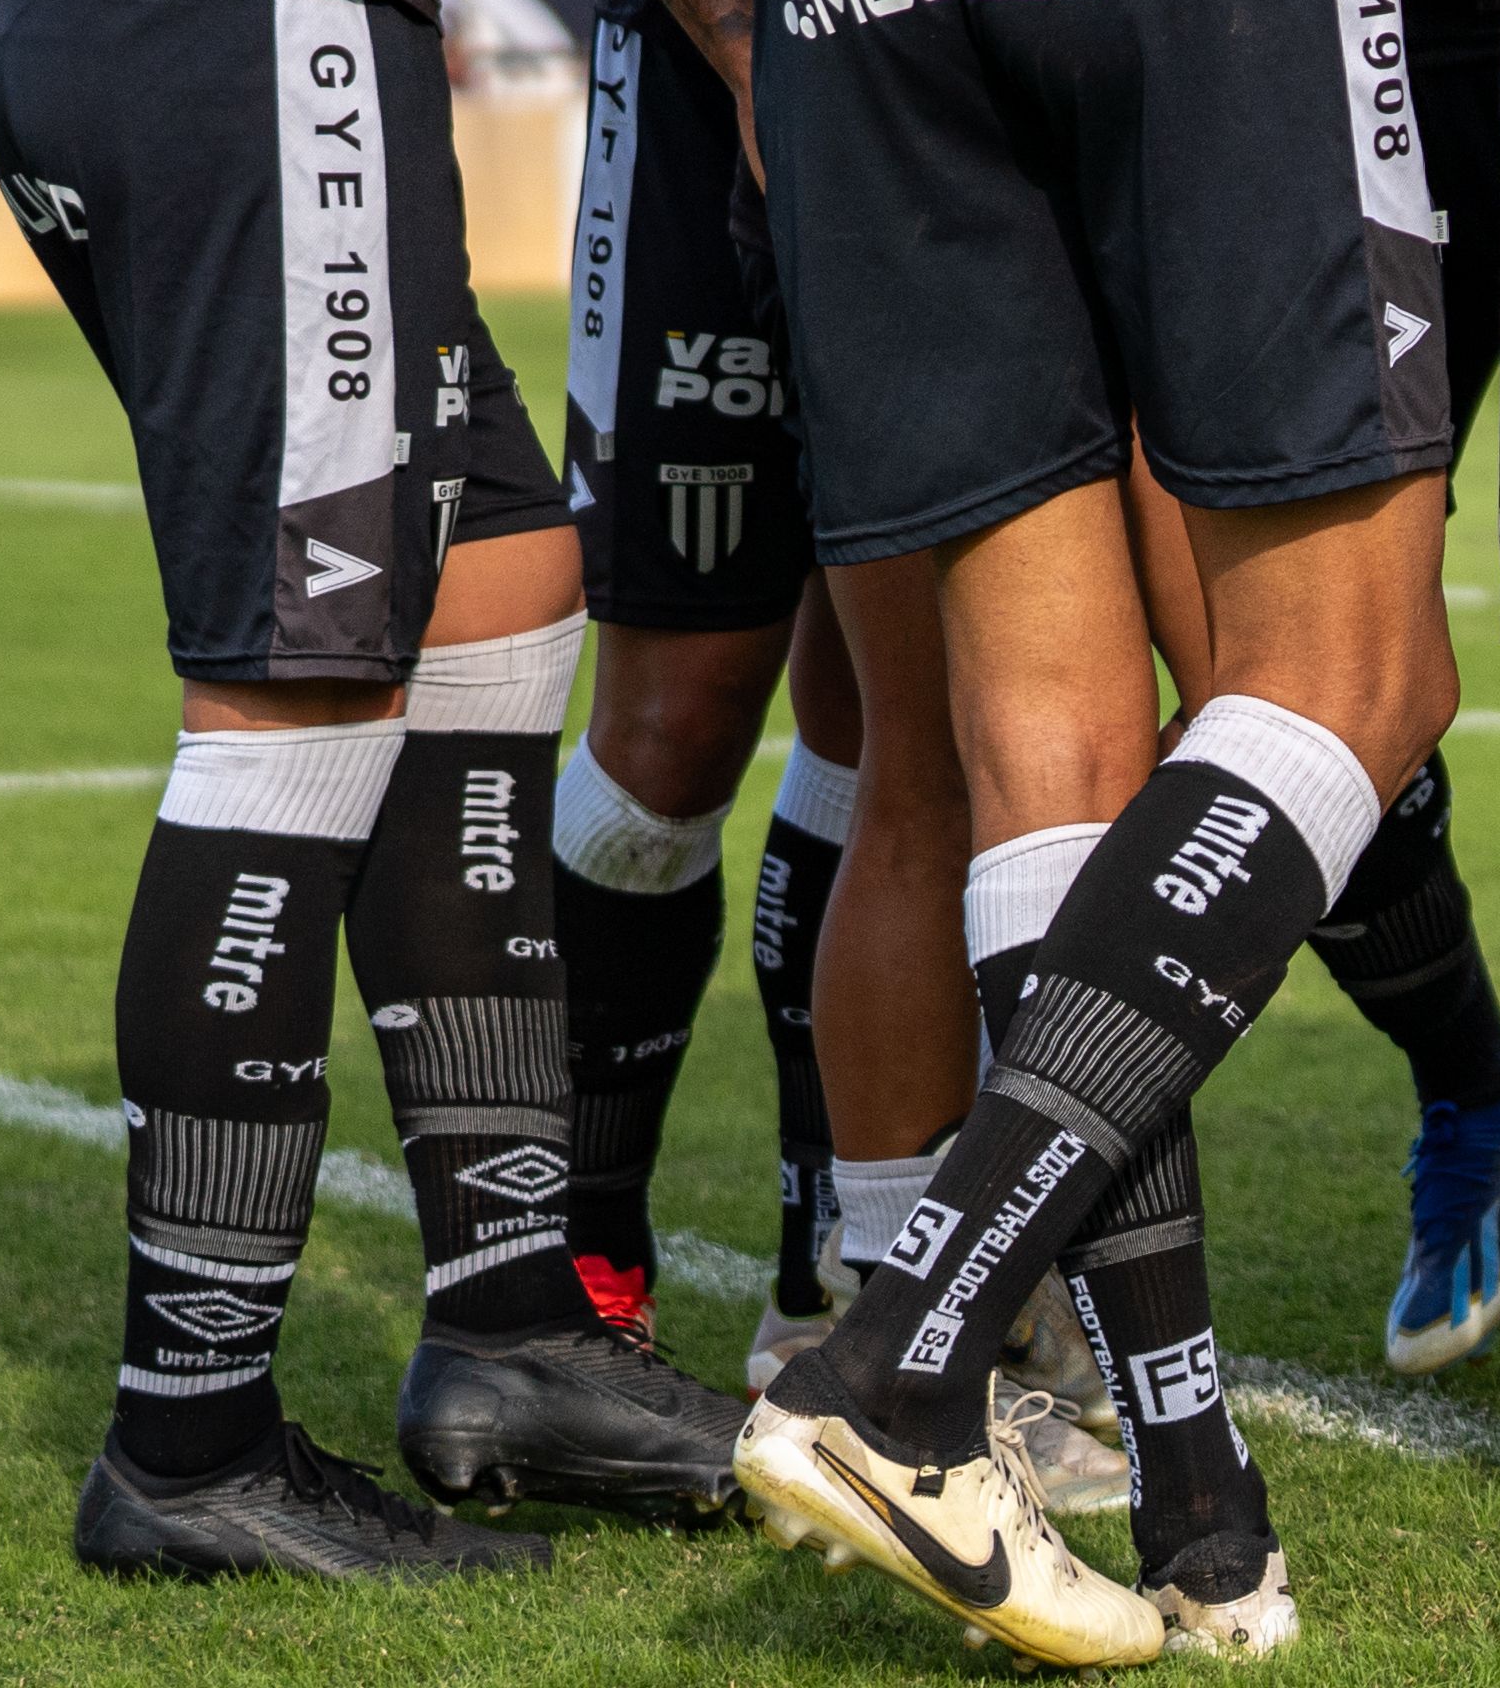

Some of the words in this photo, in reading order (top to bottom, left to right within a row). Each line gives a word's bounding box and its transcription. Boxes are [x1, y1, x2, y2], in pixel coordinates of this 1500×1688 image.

[310, 44, 364, 211] GYE
[321, 250, 372, 403] 1908
[584, 199, 616, 341] 1908
[461, 770, 521, 893] mitre
[1154, 795, 1273, 918] mitre
[203, 873, 291, 1013] mitre
[754, 853, 797, 970] mitre
[910, 1326, 950, 1370] FS
[1143, 1338, 1218, 1417] FS
